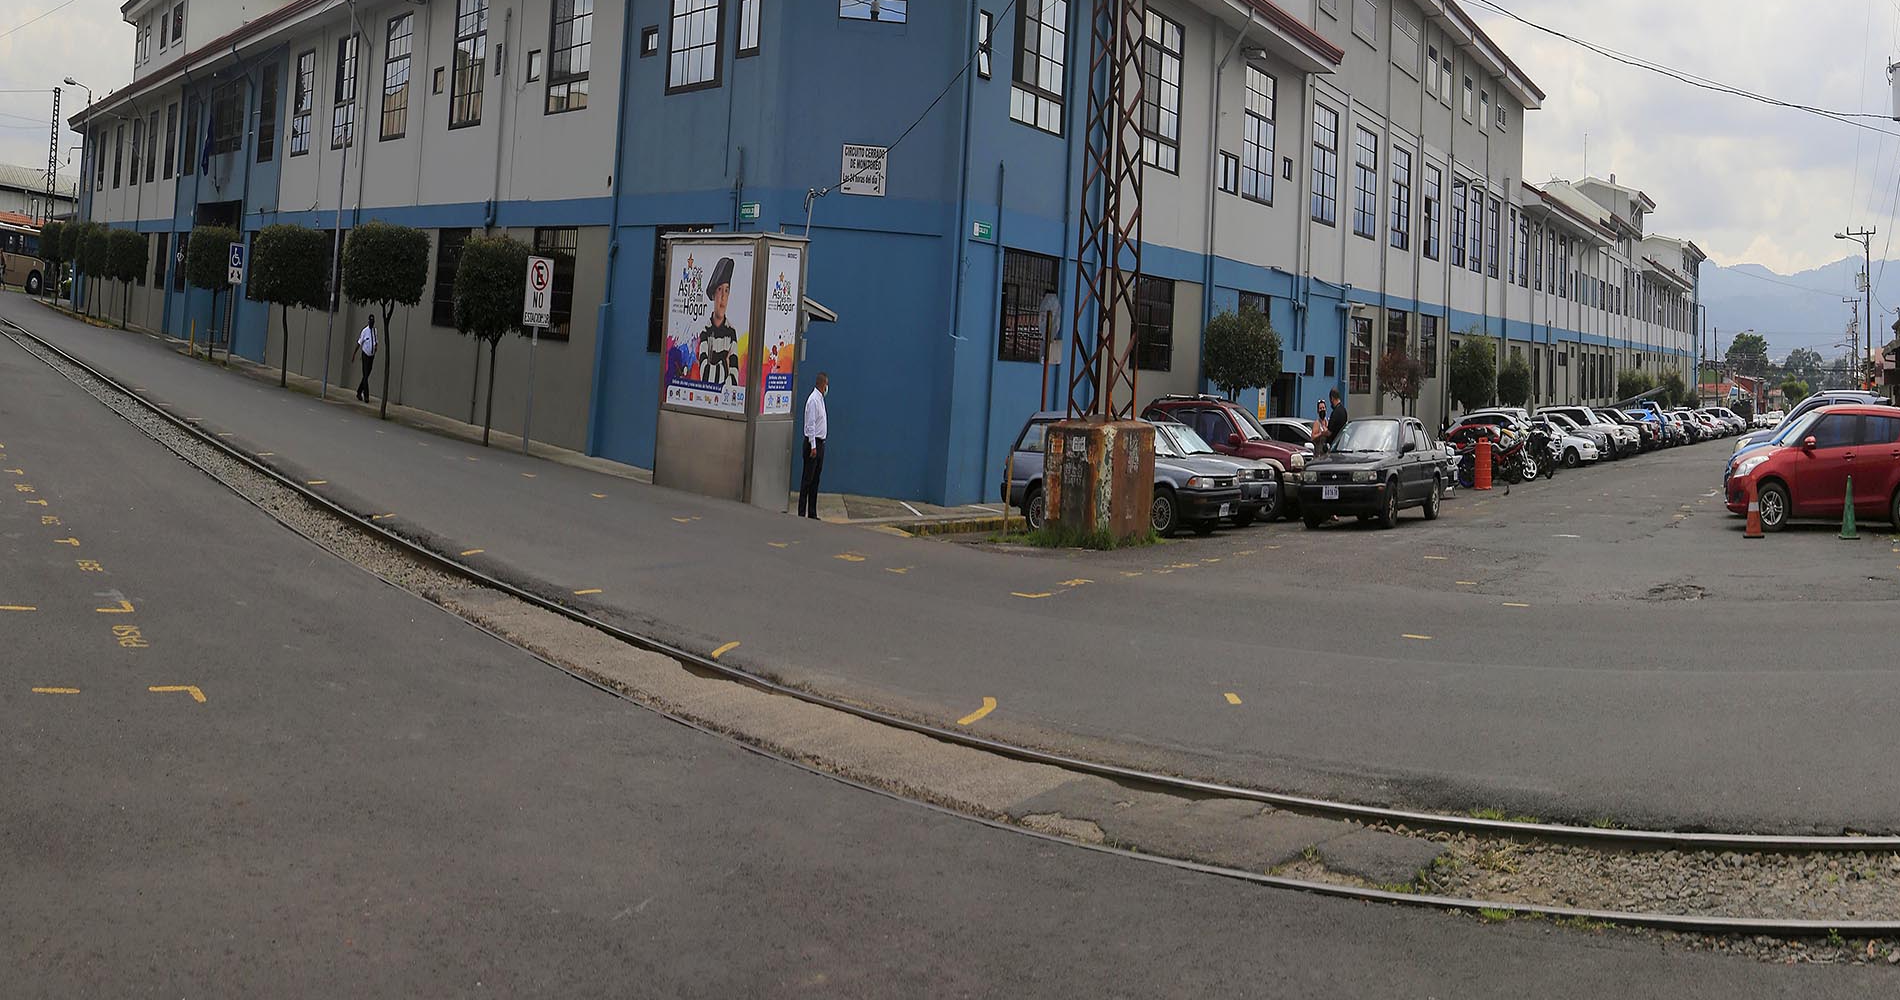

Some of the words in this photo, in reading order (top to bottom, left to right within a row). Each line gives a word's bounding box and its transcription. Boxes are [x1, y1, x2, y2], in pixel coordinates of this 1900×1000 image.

[533, 292, 543, 308] NO
[684, 299, 707, 321] Hogar
[776, 301, 796, 316] Hogar
